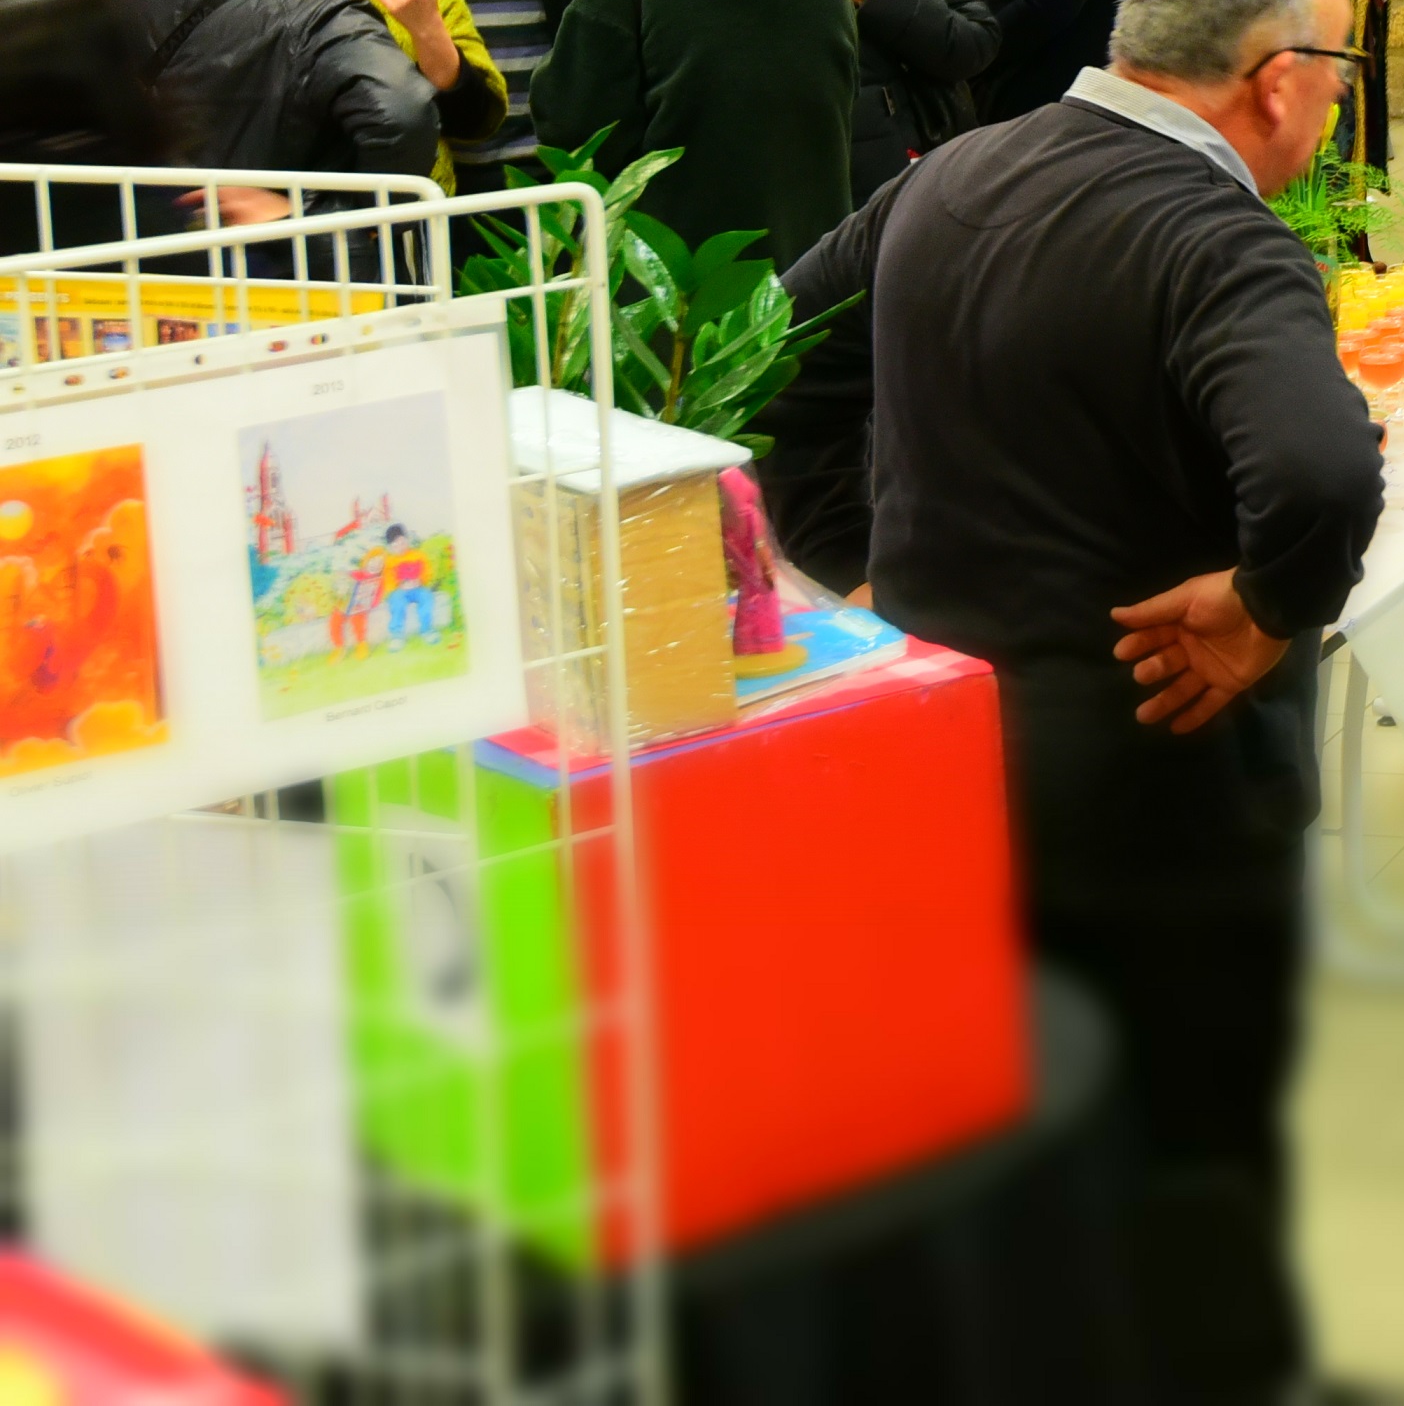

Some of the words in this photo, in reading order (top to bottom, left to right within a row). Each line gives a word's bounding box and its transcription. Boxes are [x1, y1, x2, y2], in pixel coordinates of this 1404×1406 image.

[313, 379, 345, 396] 2013
[5, 432, 42, 451] 2012
[325, 704, 372, 723] Bernard
